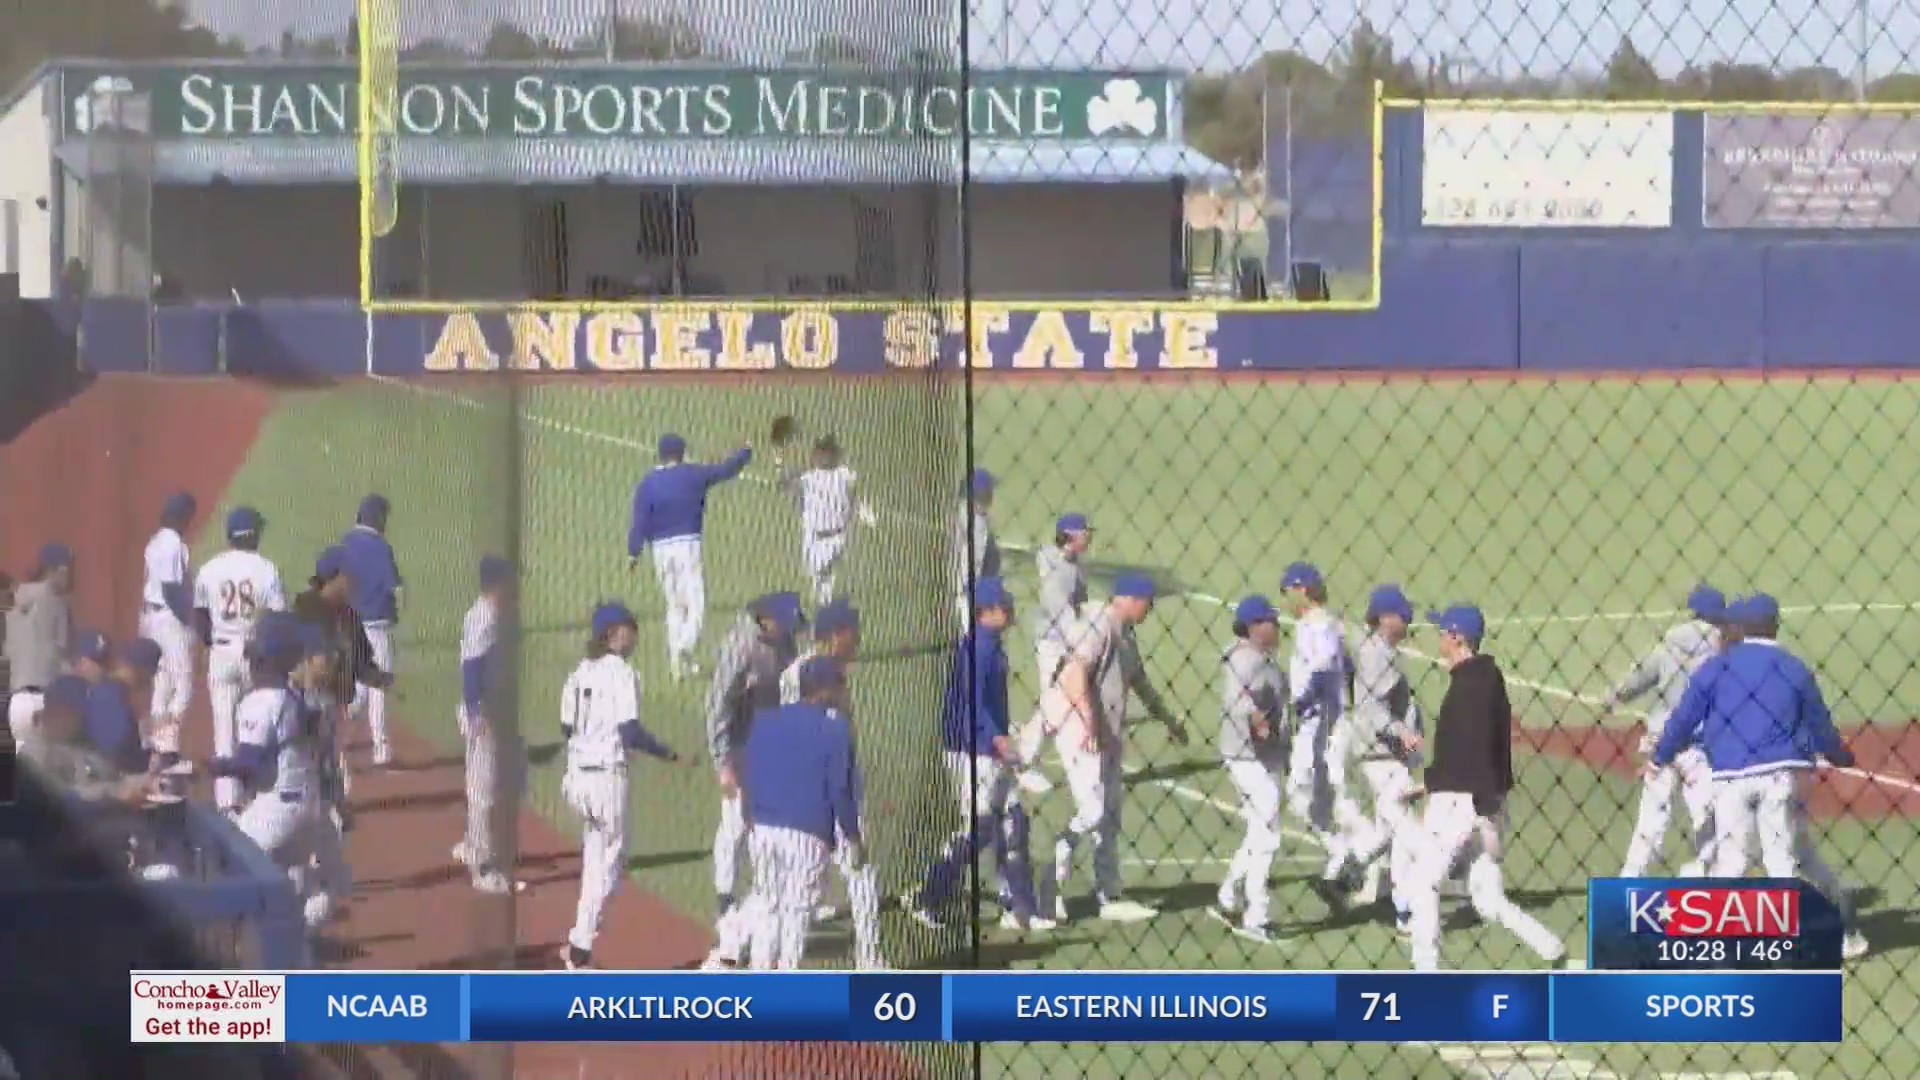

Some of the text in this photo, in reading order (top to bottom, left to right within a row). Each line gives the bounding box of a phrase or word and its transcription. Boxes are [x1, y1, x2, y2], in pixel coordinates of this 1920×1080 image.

[180, 74, 1064, 135] SHANNON SPORTS MEDICINE
[424, 308, 1219, 370] ANGELO STATE
[220, 579, 256, 620] 28
